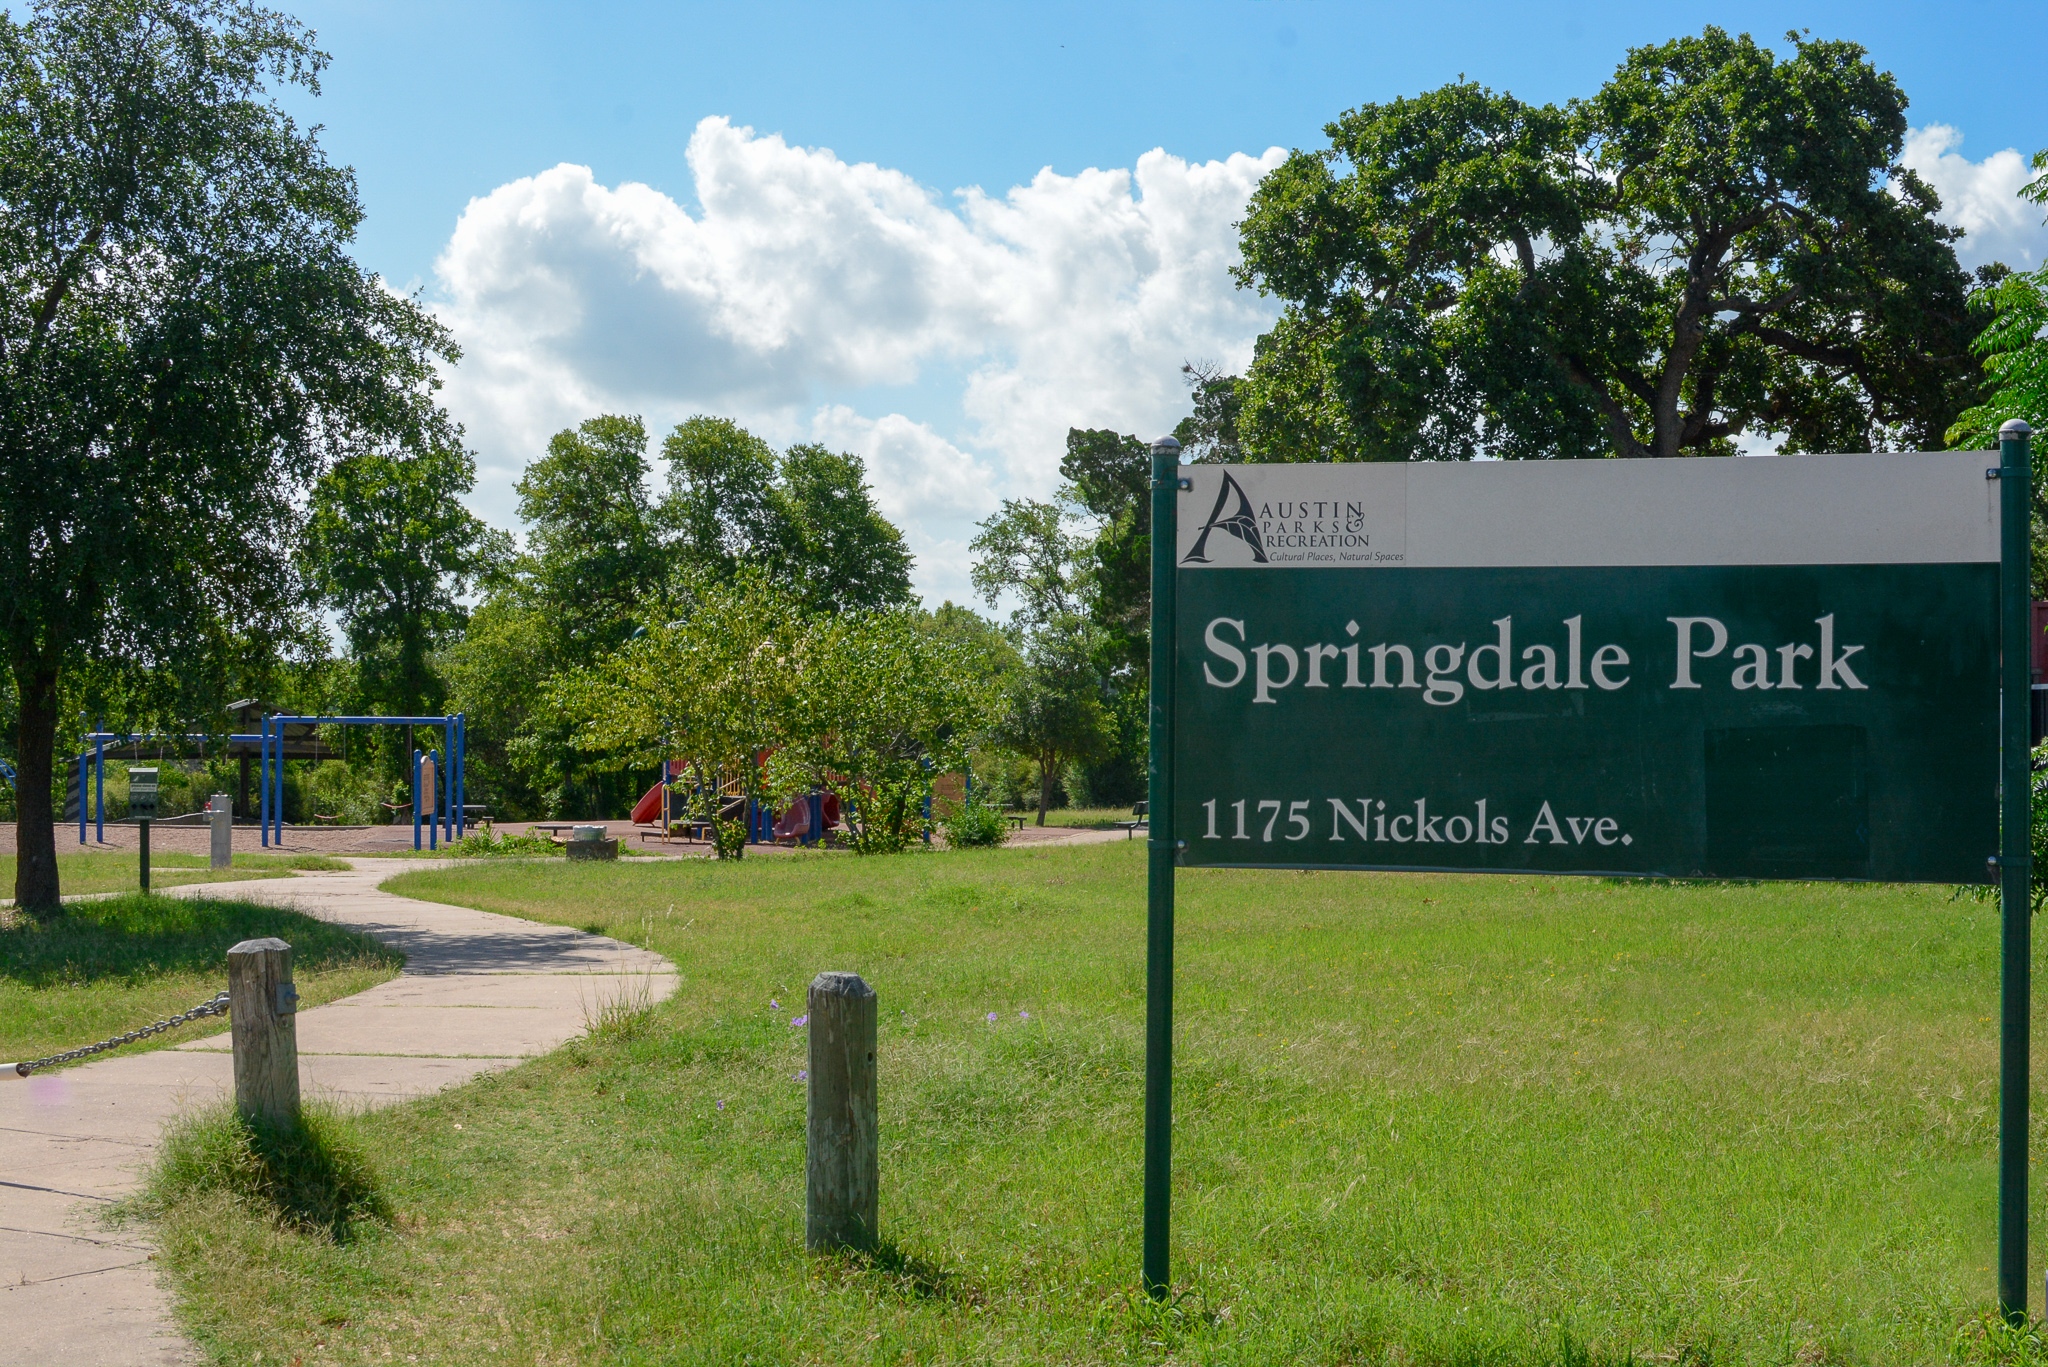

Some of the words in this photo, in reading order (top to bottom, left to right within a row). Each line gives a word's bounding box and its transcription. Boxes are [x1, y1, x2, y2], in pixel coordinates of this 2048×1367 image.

[1258, 501, 1363, 519] AUSTIN
[1266, 534, 1370, 548] RECREATION
[1269, 551, 1305, 562] Cultural
[1307, 551, 1336, 562] Places,
[1339, 551, 1373, 561] Natural
[1374, 551, 1404, 562] Spaces
[1203, 614, 1630, 706] Springdale
[1666, 613, 1869, 690] Park
[1202, 798, 1310, 842] 1175
[1326, 797, 1509, 844] Nickols
[1523, 800, 1633, 846] Ave.
